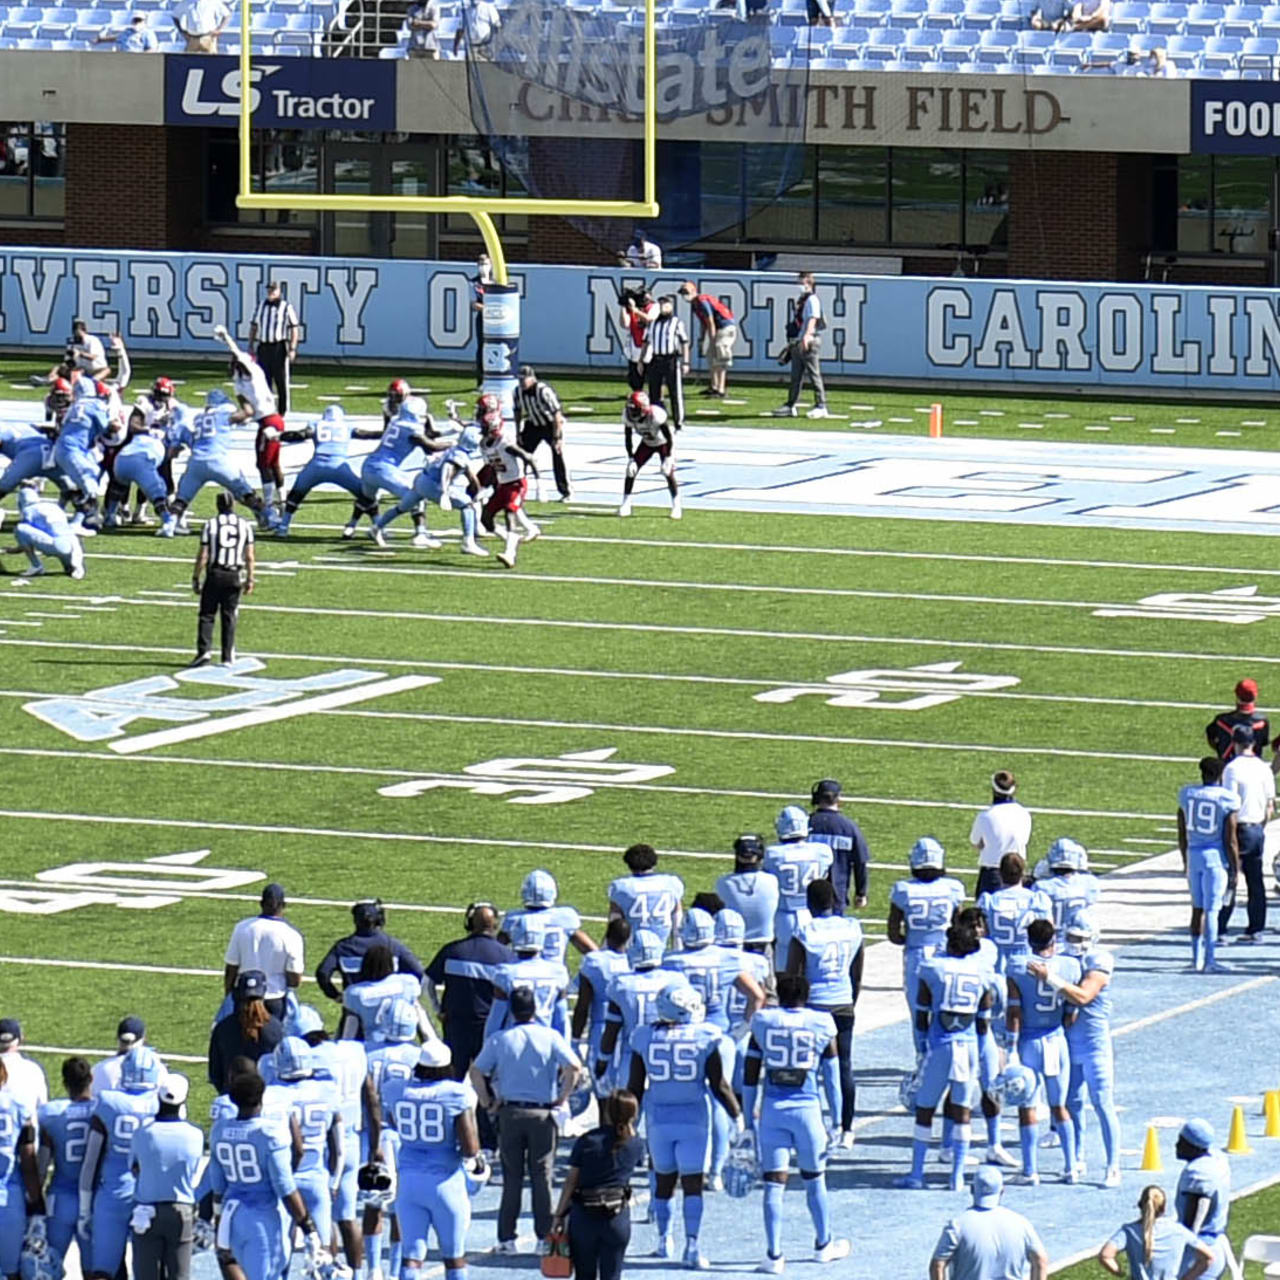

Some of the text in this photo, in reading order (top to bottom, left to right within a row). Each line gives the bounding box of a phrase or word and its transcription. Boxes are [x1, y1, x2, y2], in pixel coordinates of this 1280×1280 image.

[272, 89, 376, 121] Tractor
[905, 85, 1061, 134] FIELD
[218, 526, 239, 548] C
[1186, 798, 1217, 835] 19
[778, 862, 821, 896] 34
[629, 893, 672, 929] 44
[907, 898, 954, 931] 23
[822, 938, 851, 982] 41
[512, 979, 557, 1018] 7
[941, 971, 982, 1014] 15
[647, 1042, 697, 1082] 55
[765, 1028, 815, 1070] 58
[290, 1102, 328, 1145] 5
[394, 1100, 445, 1143] 88
[216, 1141, 263, 1185] 98
